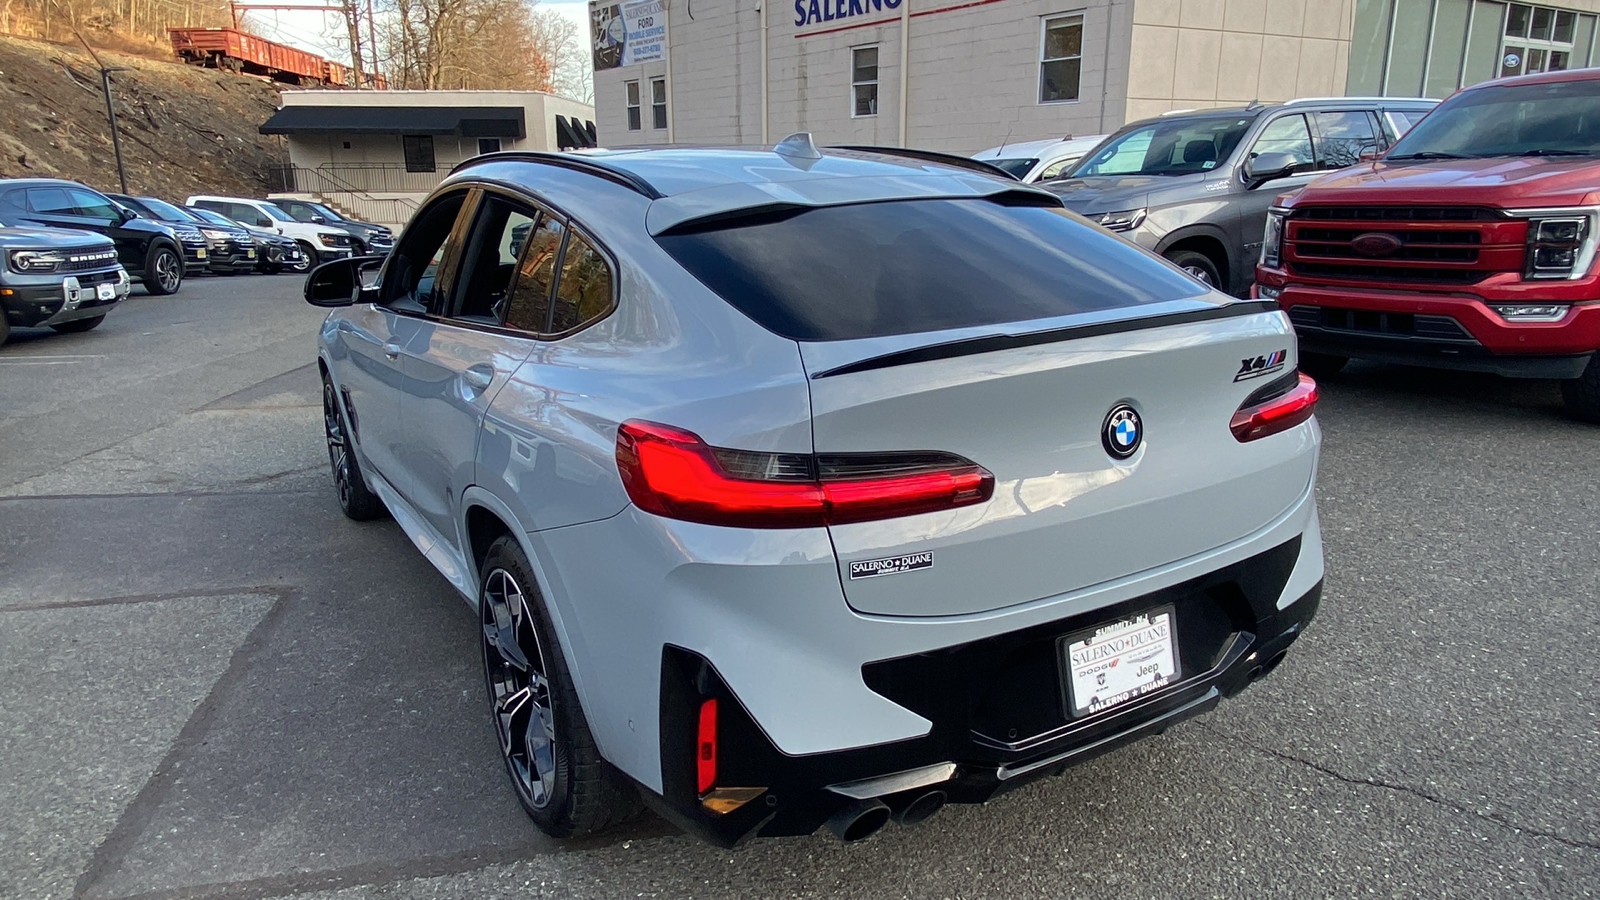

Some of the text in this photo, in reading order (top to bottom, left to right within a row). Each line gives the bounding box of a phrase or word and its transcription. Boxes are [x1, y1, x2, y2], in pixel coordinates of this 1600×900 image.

[637, 16, 654, 29] FORD
[70, 252, 114, 262] BRONCO
[1111, 411, 1138, 428] BMW
[852, 553, 932, 573] SALERNO DUANE
[1072, 624, 1168, 667] SALERNO DUANE
[1136, 662, 1159, 677] Jeep
[1089, 677, 1169, 713] SALERNO DUANE
